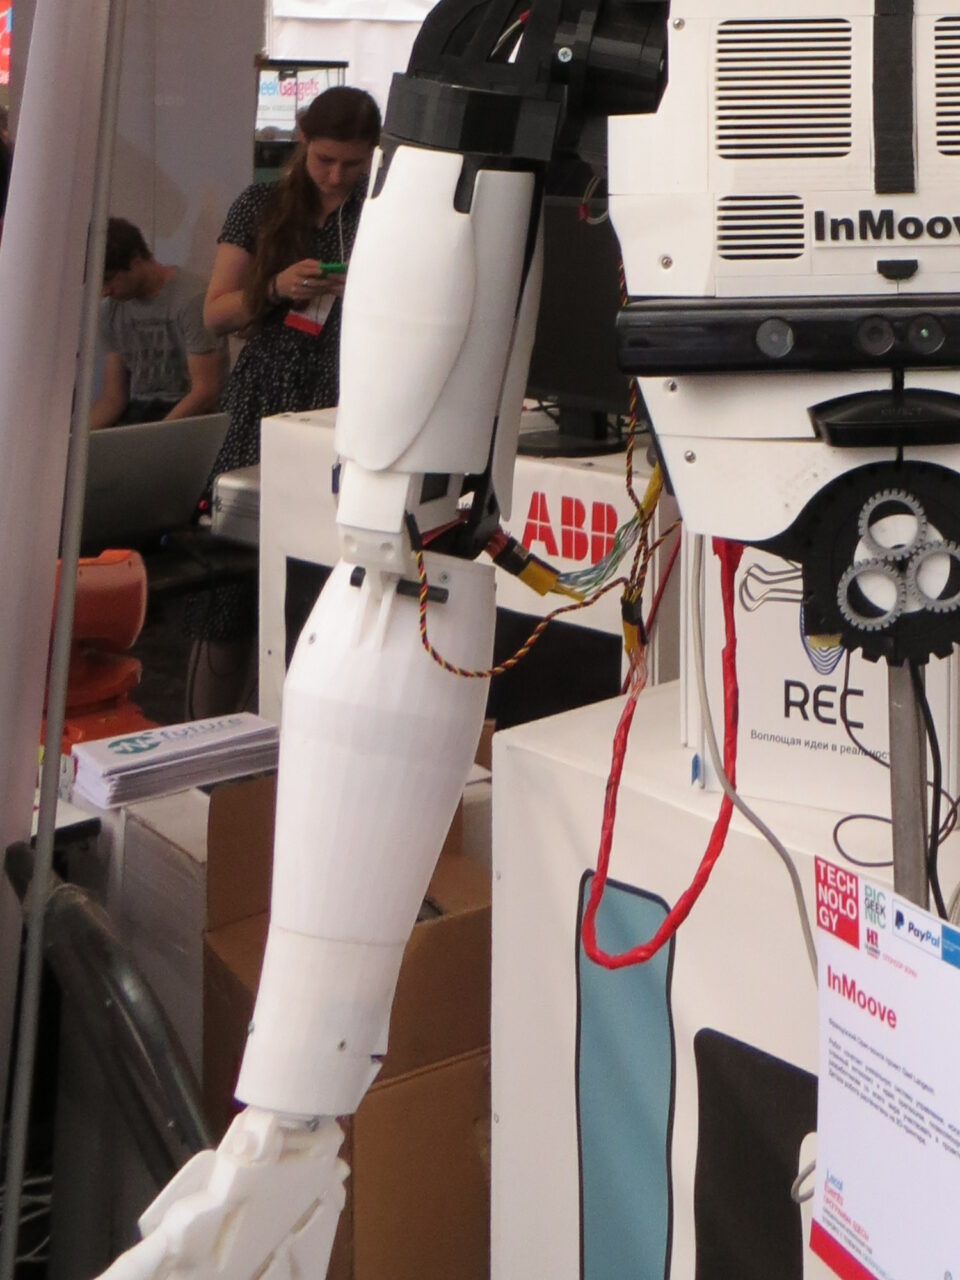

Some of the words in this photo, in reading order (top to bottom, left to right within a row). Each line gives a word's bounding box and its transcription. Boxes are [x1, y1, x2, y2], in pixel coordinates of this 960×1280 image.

[522, 490, 619, 567] ABB
[784, 679, 864, 730] REC
[750, 729, 802, 747] Воплощая
[804, 738, 829, 752] идеи
[831, 742, 838, 752] в
[817, 860, 857, 898] TECH
[818, 882, 857, 921] NOLO
[819, 906, 839, 932] GY
[908, 922, 940, 948] PayPal
[826, 964, 898, 1030] InMoove
